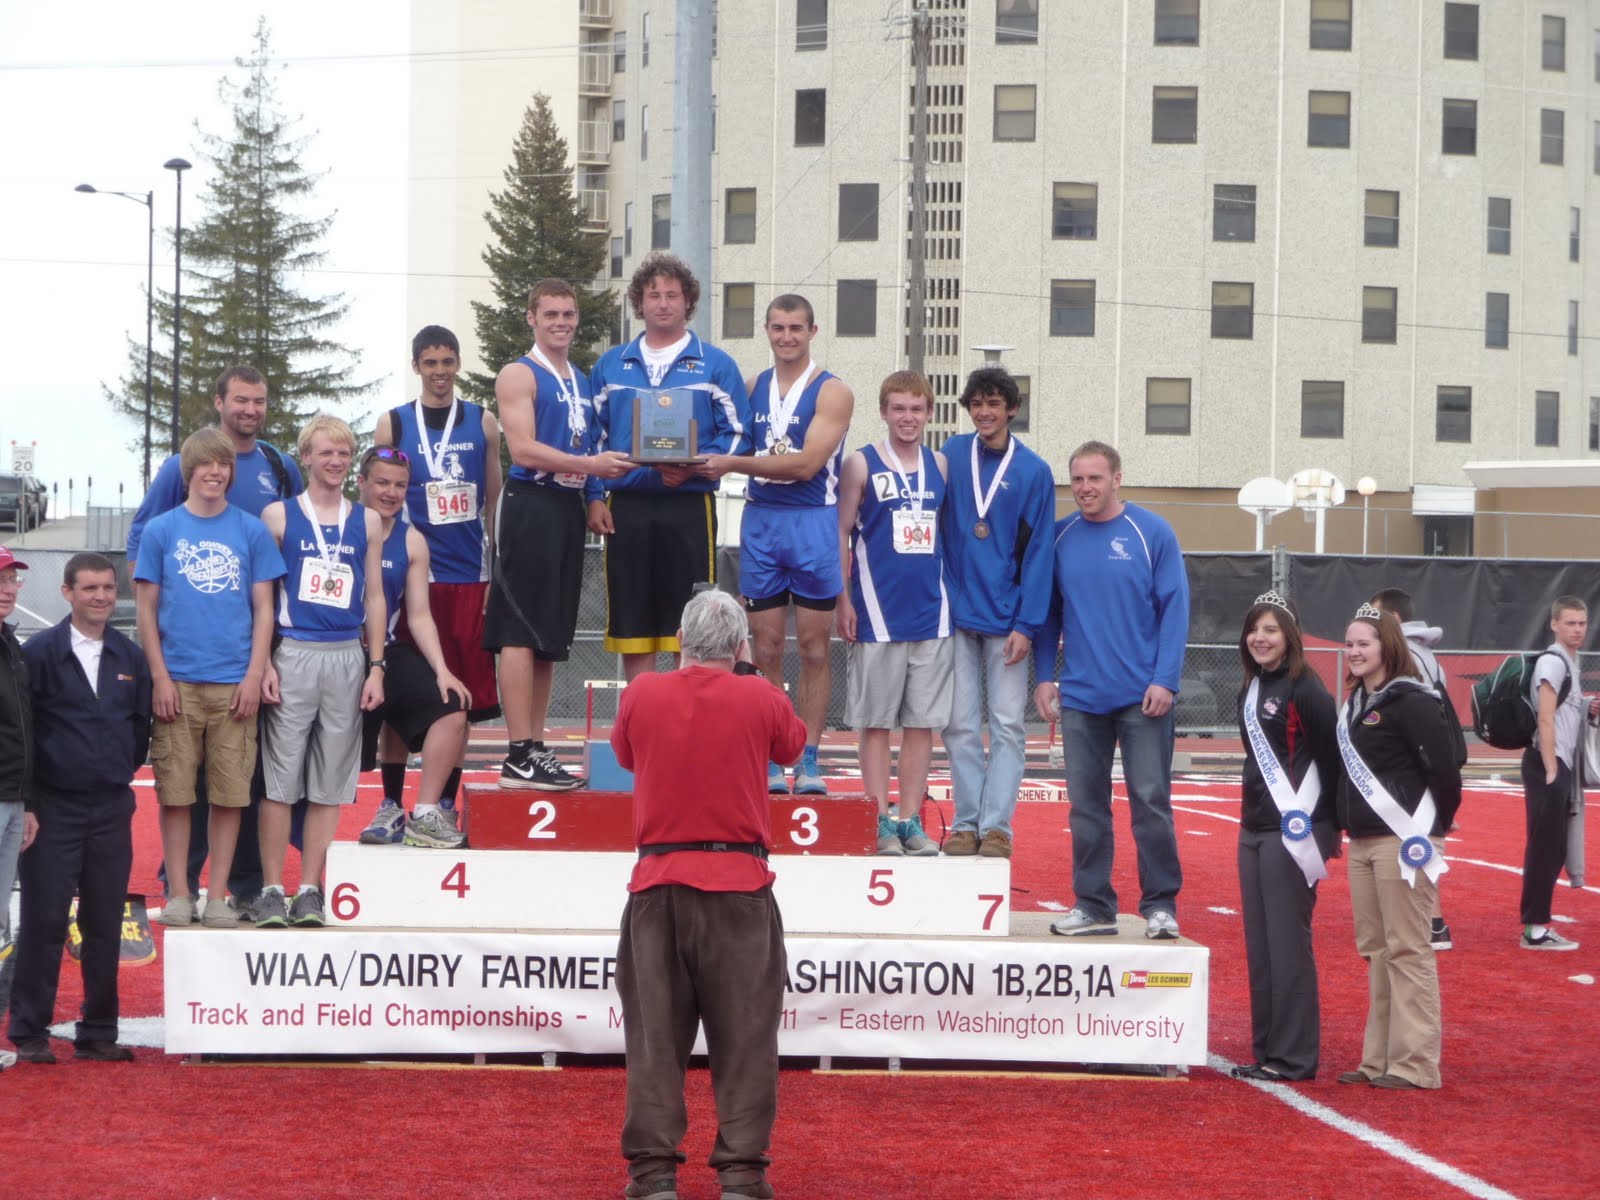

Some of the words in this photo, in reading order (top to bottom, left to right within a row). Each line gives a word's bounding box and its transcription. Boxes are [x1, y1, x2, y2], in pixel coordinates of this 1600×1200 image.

[755, 412, 766, 423] LA
[14, 460, 33, 472] 20
[437, 492, 469, 516] 946
[877, 474, 895, 499] 2
[301, 540, 315, 551] LA
[309, 573, 344, 598] 98
[1248, 729, 1278, 788] AMBASSADOR
[1342, 746, 1375, 799] AMBASSADOR
[1016, 790, 1053, 801] CHENEY
[528, 800, 557, 839] 2
[789, 806, 820, 847] 3
[440, 861, 472, 899] 4
[866, 869, 896, 907] 5
[330, 882, 361, 921] 6
[977, 894, 1005, 931] 7
[245, 950, 463, 991] WIAA/DAIRY
[1147, 976, 1159, 984] LES
[1160, 976, 1190, 984] SCHWAB
[187, 1002, 249, 1026] Track
[261, 1003, 304, 1026] and
[316, 1002, 373, 1027] Field
[384, 1002, 564, 1032] Championships
[839, 1007, 926, 1032] Eastern
[937, 1010, 1065, 1040] Washington
[1076, 1012, 1185, 1044] University
